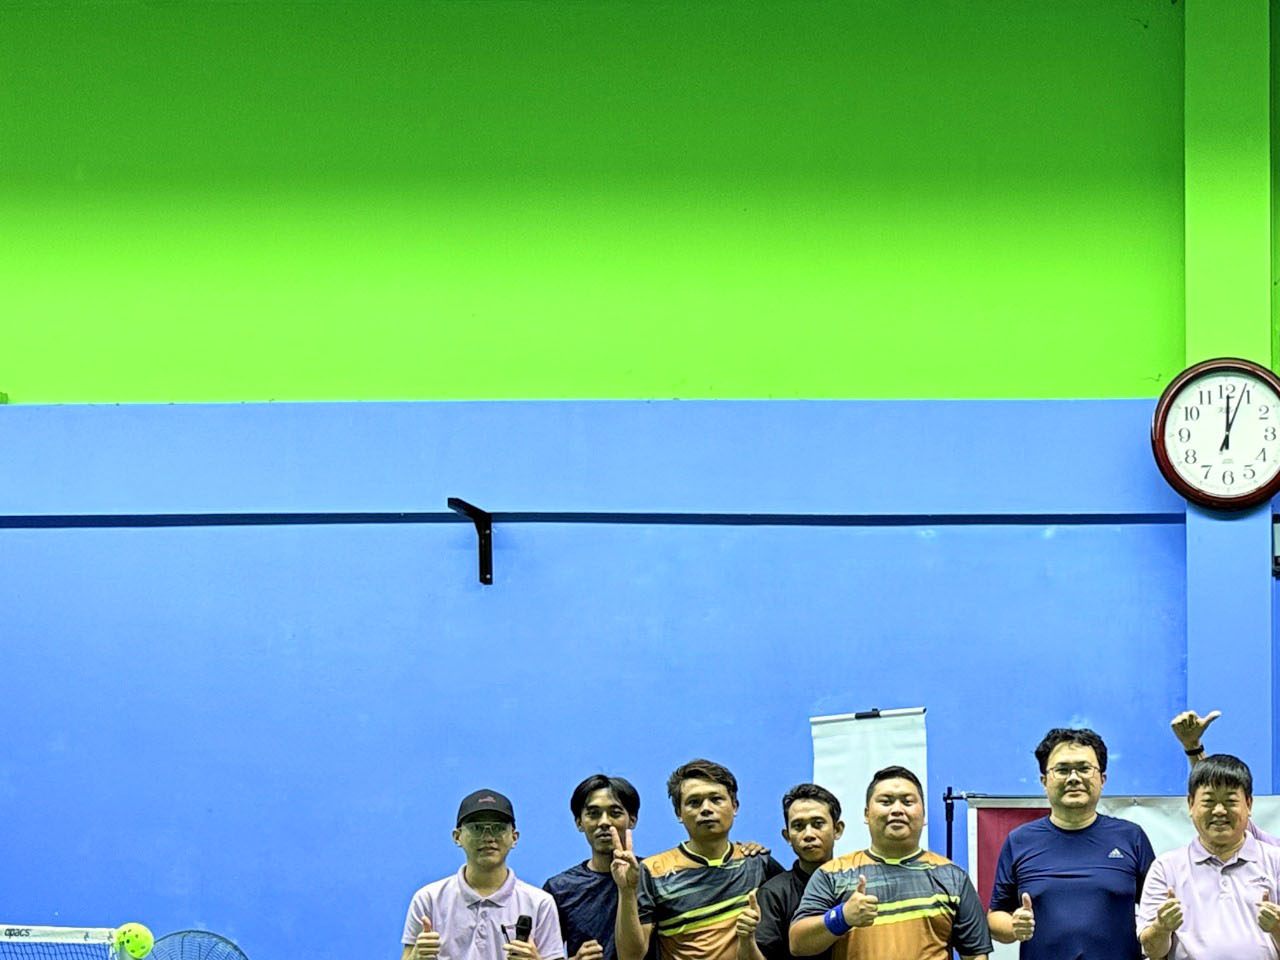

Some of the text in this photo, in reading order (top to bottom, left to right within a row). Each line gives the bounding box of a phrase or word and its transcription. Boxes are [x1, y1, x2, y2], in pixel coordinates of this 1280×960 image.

[1199, 390, 1212, 405] 11
[1218, 384, 1236, 399] 12
[1246, 390, 1251, 404] 1
[1184, 406, 1200, 421] 10
[1258, 405, 1269, 420] 2
[1178, 428, 1191, 442] 9
[1264, 426, 1277, 441] 3
[1184, 449, 1197, 464] 8
[1256, 447, 1267, 462] 4
[1201, 464, 1212, 480] 7
[1222, 470, 1234, 485] 6
[1243, 464, 1256, 479] 5
